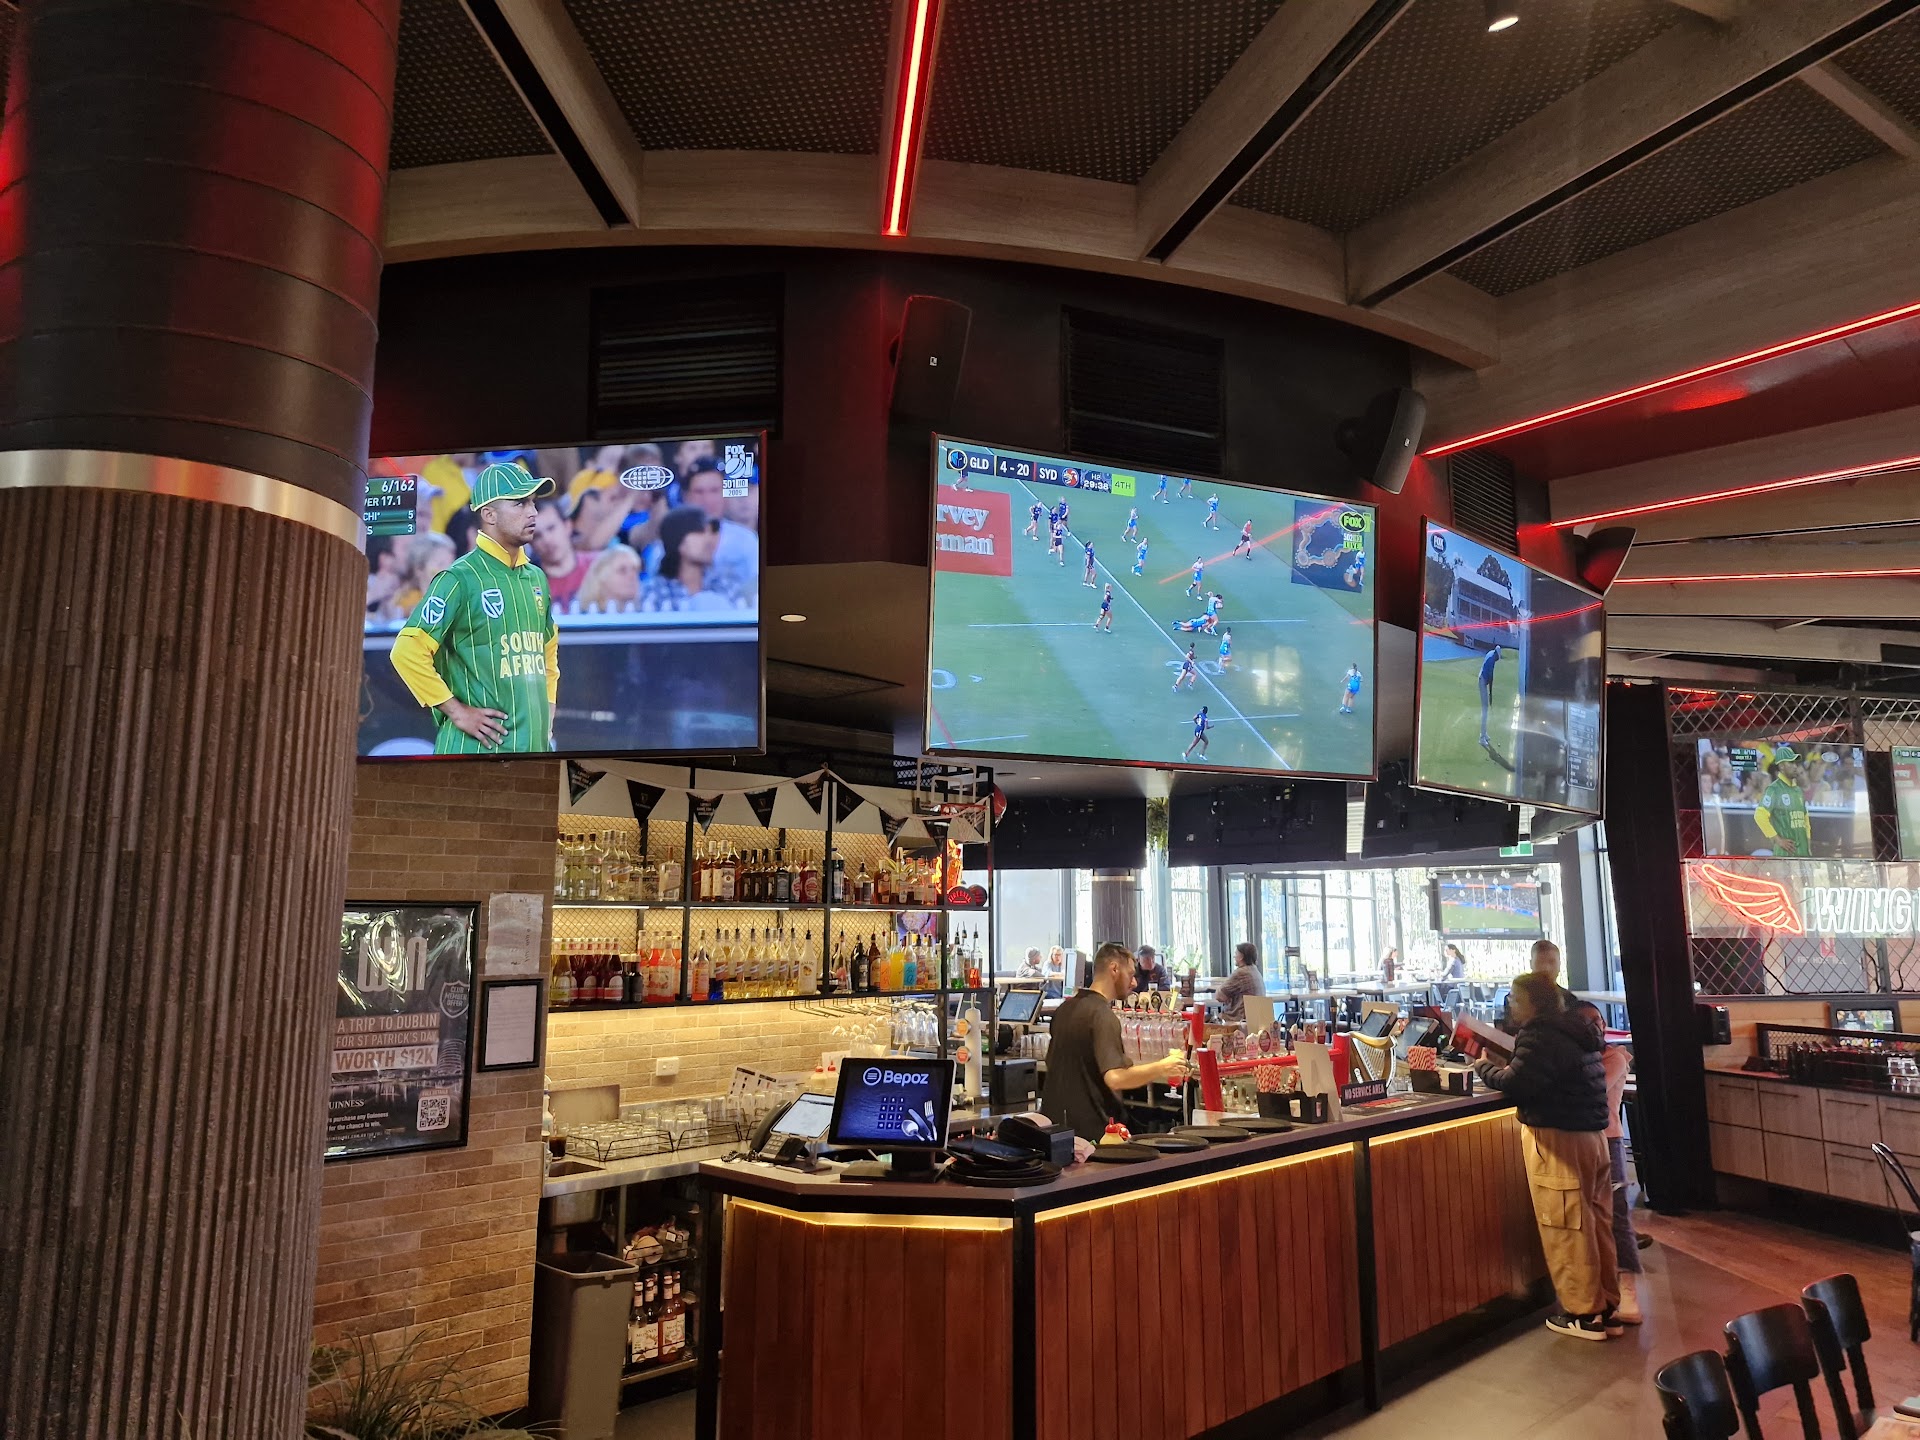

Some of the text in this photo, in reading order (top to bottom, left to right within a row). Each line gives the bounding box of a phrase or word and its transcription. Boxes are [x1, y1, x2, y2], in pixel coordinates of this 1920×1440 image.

[725, 444, 745, 454] FOX
[970, 457, 990, 470] GLD
[1000, 462, 1008, 474] 4
[1016, 464, 1030, 476] 20
[1039, 468, 1058, 480] SYD
[382, 480, 414, 493] 6/162
[723, 480, 736, 488] 501
[1114, 480, 1131, 489] 4TH
[381, 496, 401, 506] 17.1
[408, 510, 414, 519] 5
[937, 504, 989, 531] rvey
[408, 524, 412, 532] 3
[1344, 516, 1362, 528] FOX
[1434, 535, 1444, 549] FOX
[500, 632, 544, 655] SOUTH
[1814, 886, 1920, 934] WING
[445, 992, 468, 1000] MEMBER
[338, 1014, 437, 1033] A TRIP TO DUBLIN
[336, 1035, 354, 1048] FOR
[358, 1034, 368, 1046] ST
[372, 1032, 418, 1045] PATRICK'S
[336, 1048, 434, 1070] WORTH $12K
[883, 1070, 929, 1086] Bepoz
[1344, 1084, 1384, 1100] NO SERVICE AREA
[328, 1099, 365, 1110] UINNESS
